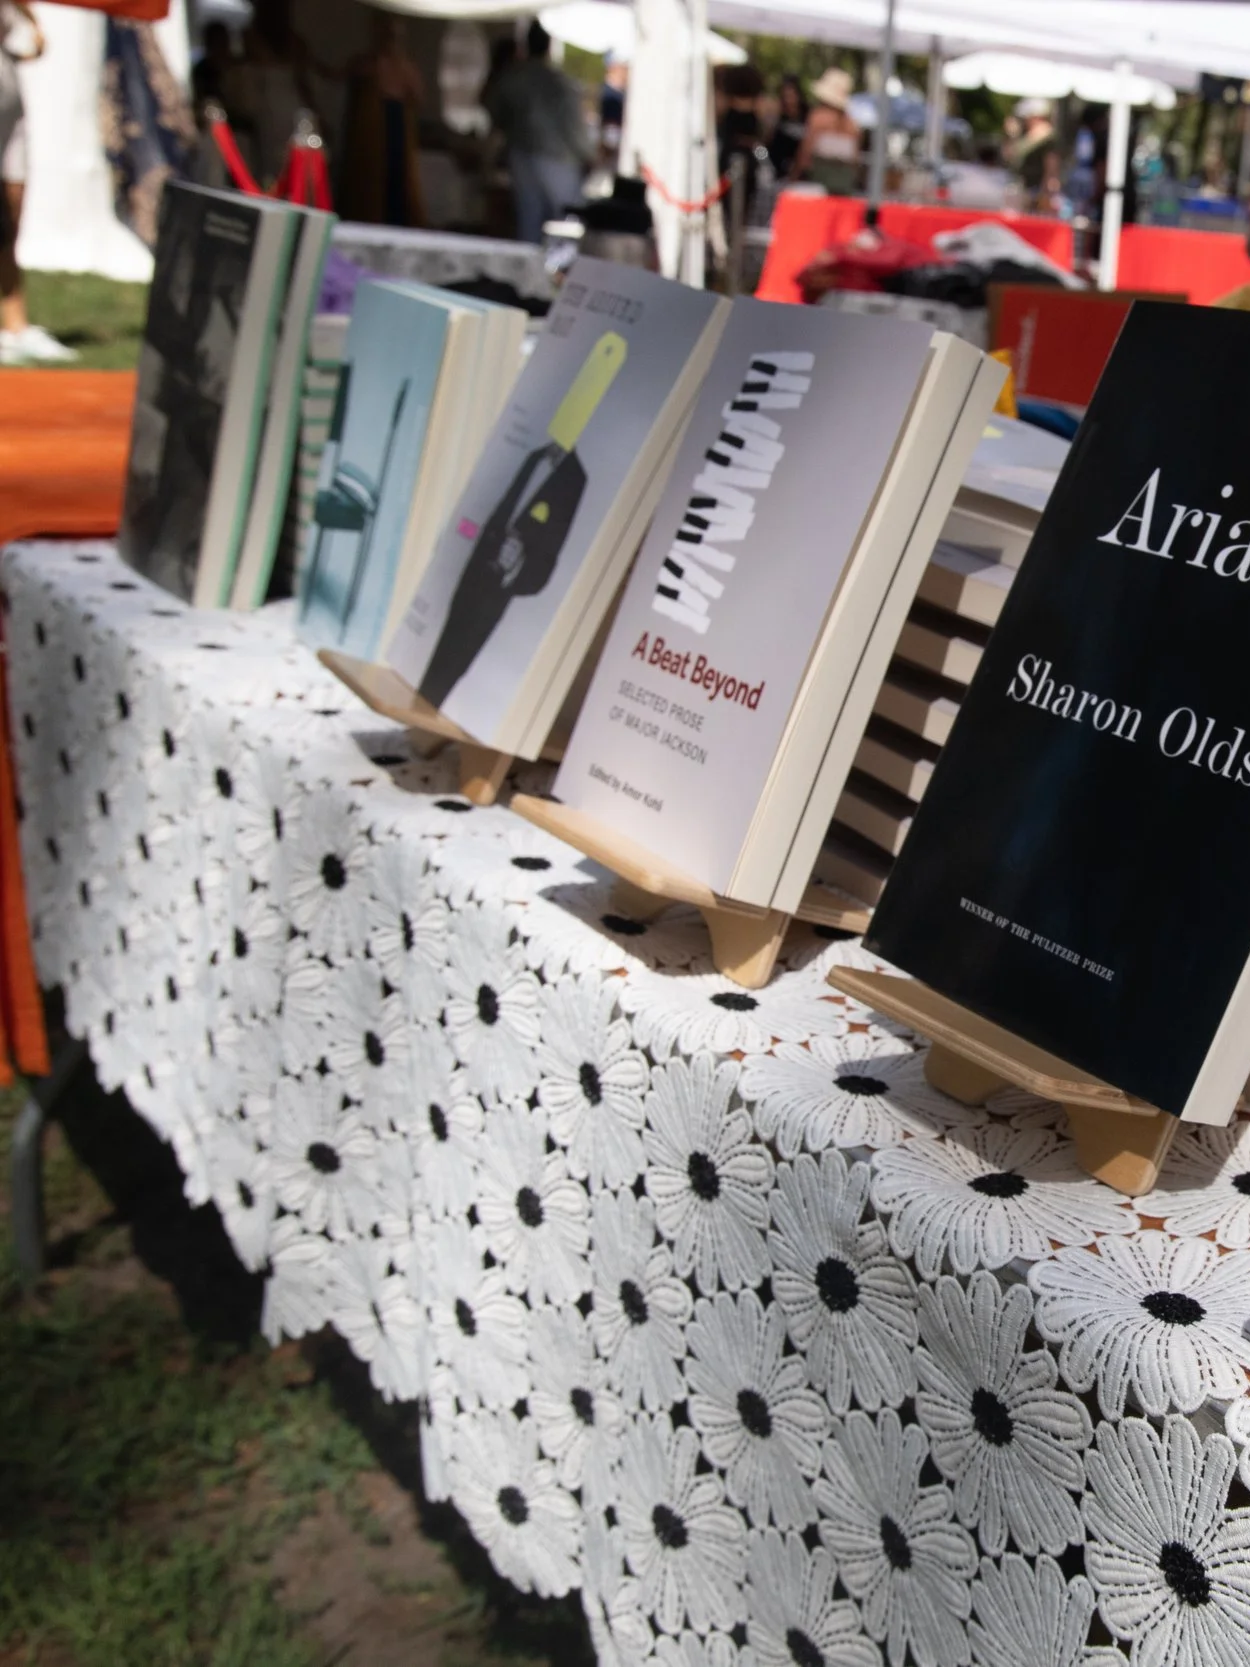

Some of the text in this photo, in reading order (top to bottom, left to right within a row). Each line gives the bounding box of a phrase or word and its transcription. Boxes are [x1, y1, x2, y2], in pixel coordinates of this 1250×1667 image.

[617, 680, 705, 732] SELECTED PROSE
[631, 631, 765, 711] A Beat Beyond
[1006, 653, 1144, 742] Sharon
[609, 706, 708, 765] OF MAJOR JACKSON
[960, 897, 1115, 981] WINNER OF THE PULITZER PRIZE
